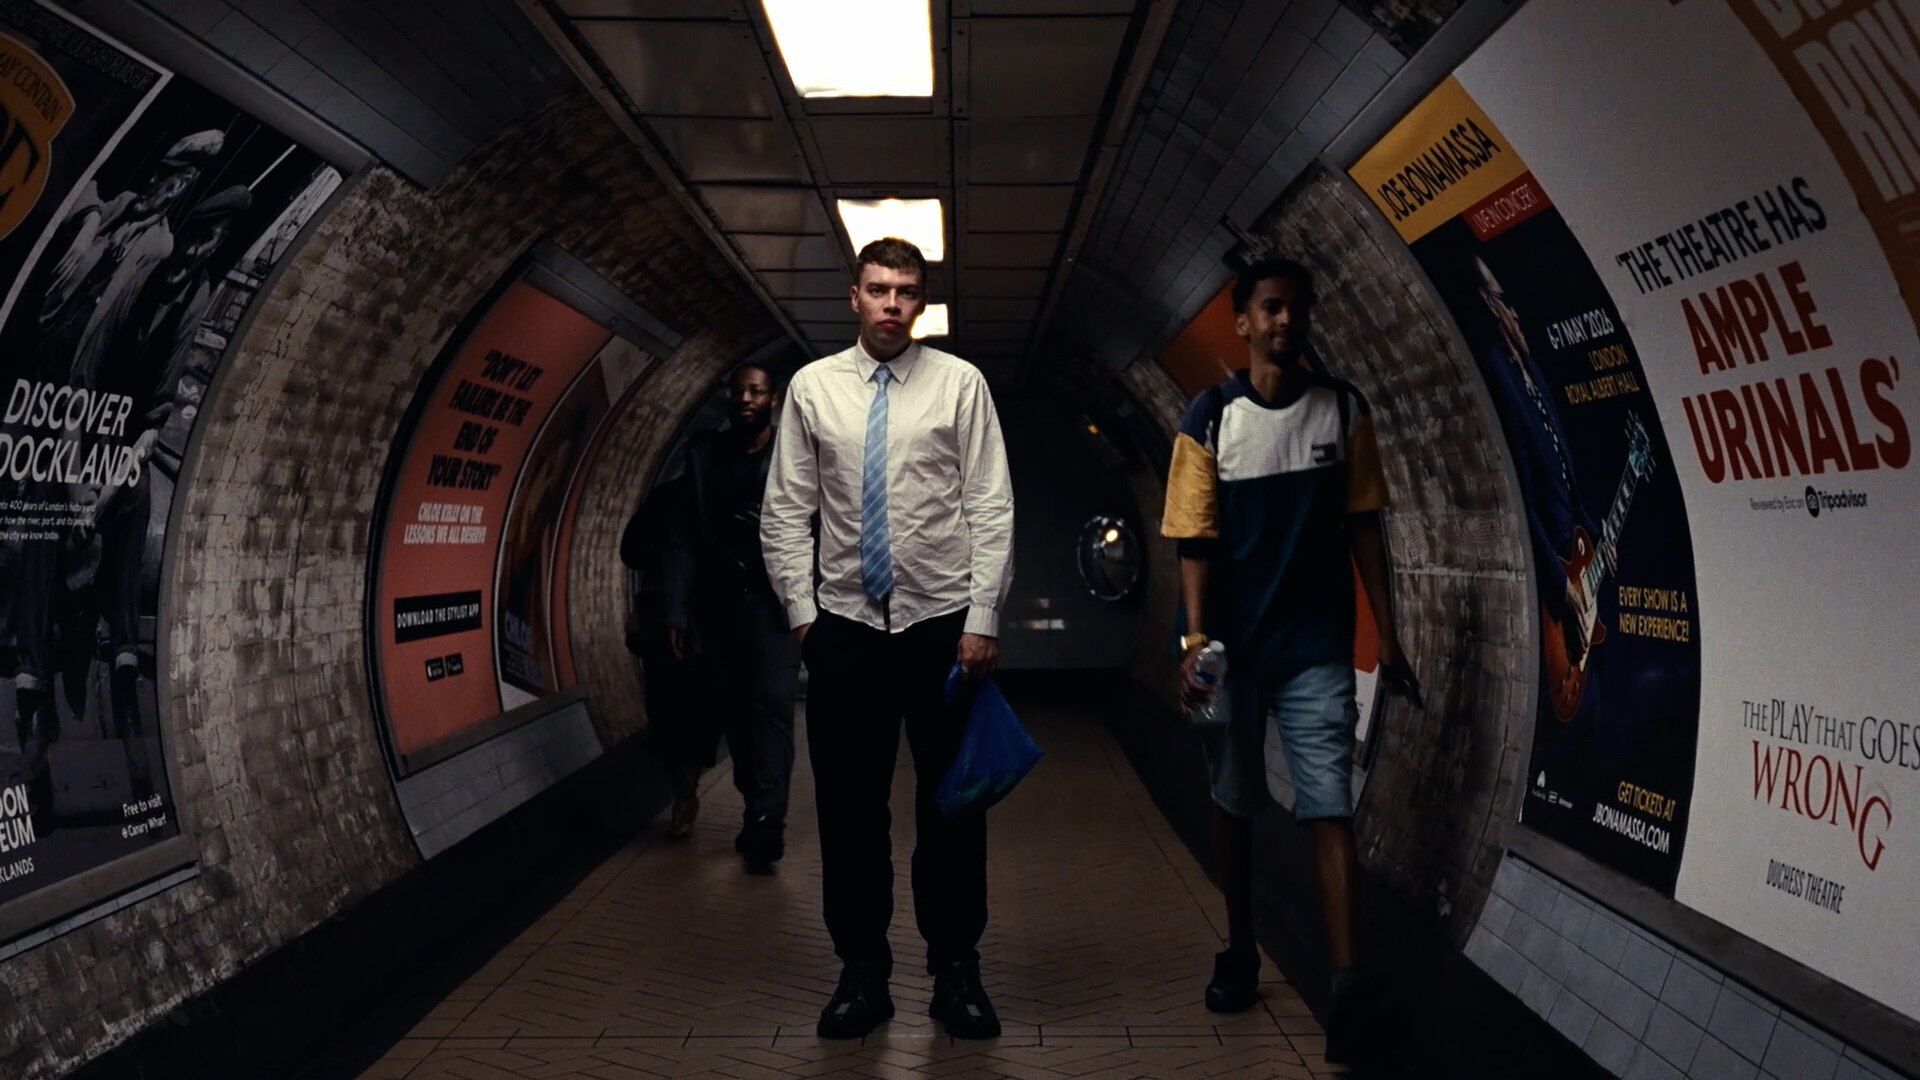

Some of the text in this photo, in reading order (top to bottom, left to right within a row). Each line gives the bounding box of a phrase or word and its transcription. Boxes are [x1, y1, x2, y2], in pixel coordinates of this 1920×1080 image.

[13, 66, 62, 122] CONTAIN
[1377, 117, 1501, 222] JOE BONAMASSA
[1472, 209, 1496, 233] LIVE
[1493, 183, 1537, 221] CONCERT
[1657, 200, 1772, 280] THEATRE
[1754, 176, 1827, 244] HAS
[1546, 307, 1615, 350] 6-7 MAY 2026
[1681, 261, 1833, 374] AMPLE
[1587, 343, 1630, 373] LONDON
[514, 364, 544, 393] LET
[1616, 370, 1641, 395] HALL
[3, 377, 134, 437] DISCOVER
[453, 421, 499, 455] END OF
[0, 432, 146, 488] DOCKLANDS
[427, 454, 462, 488] YOUR
[9, 499, 23, 511] 400
[459, 504, 473, 524] ON
[1818, 489, 1867, 512] Tripadvisor
[396, 608, 434, 629] DOWNLOAD
[434, 607, 447, 623] THE
[468, 602, 480, 618] APP
[1618, 585, 1689, 614] EVERY SHOW IS A
[1619, 612, 1691, 643] NEW EXPERIENCE!
[1743, 700, 1768, 732] THE
[1770, 699, 1814, 745] PLAY
[1815, 714, 1856, 751] THAT
[122, 802, 140, 818] Free
[138, 799, 148, 812] to
[1617, 780, 1677, 822] GET TICKETS AT
[1752, 740, 1892, 871] WRONG
[127, 822, 149, 837] Canary
[146, 812, 167, 829] Wharf
[1766, 859, 1846, 914] DUCHESS THEATRE
